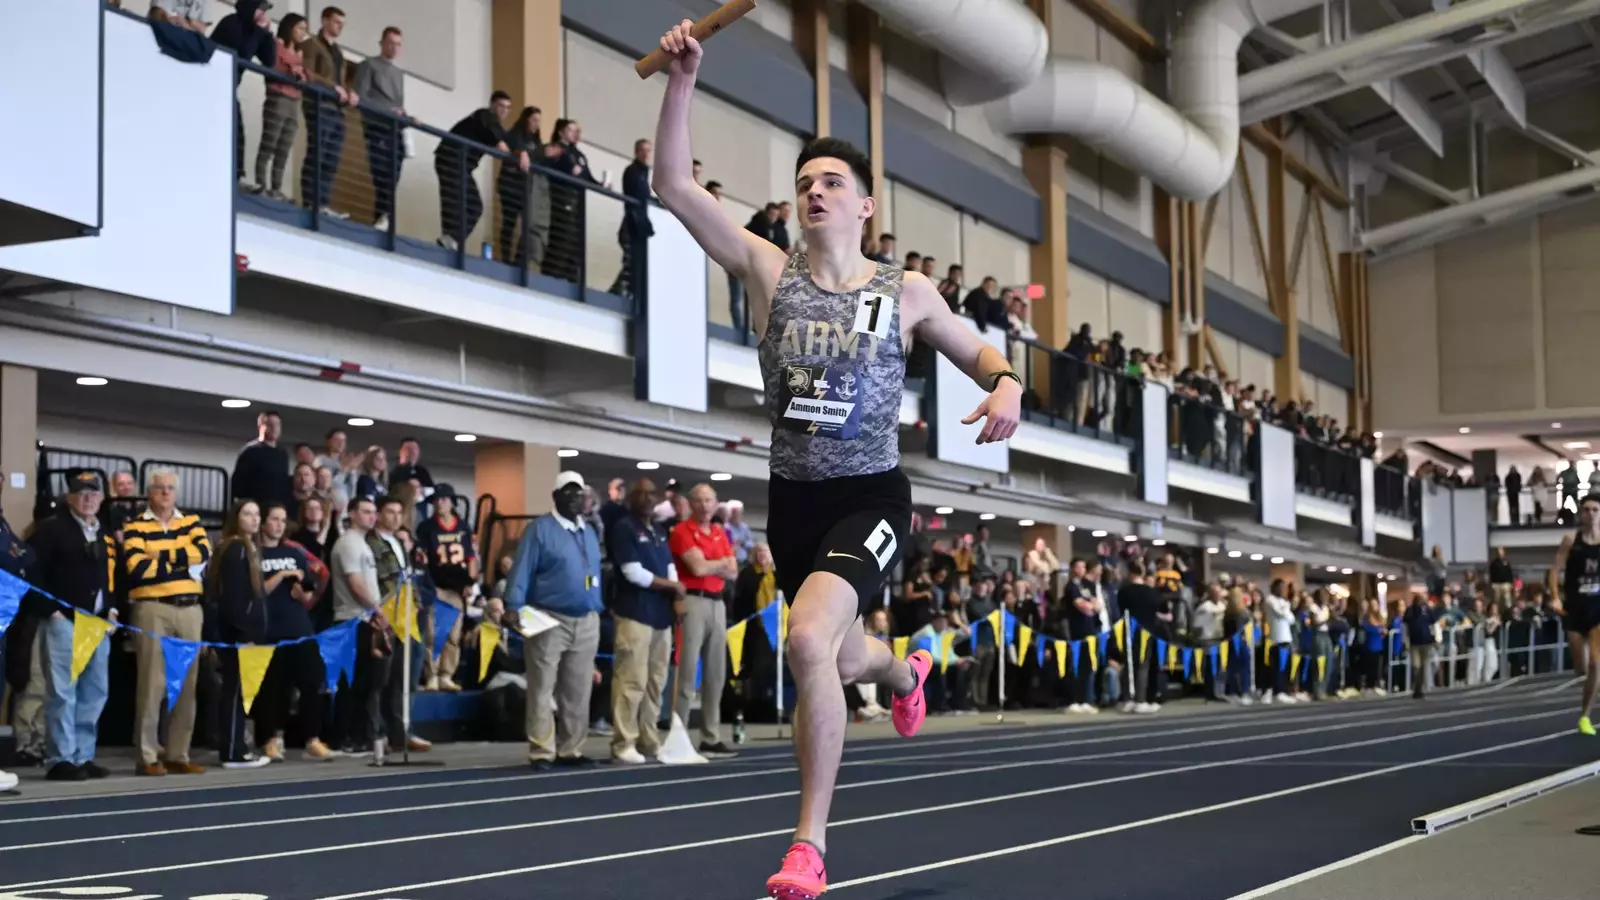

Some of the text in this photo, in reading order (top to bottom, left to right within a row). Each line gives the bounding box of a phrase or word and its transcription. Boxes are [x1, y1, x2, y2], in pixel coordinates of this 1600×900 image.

[864, 296, 883, 332] 1
[790, 401, 847, 418] Ammon Smith
[875, 528, 894, 559] 1
